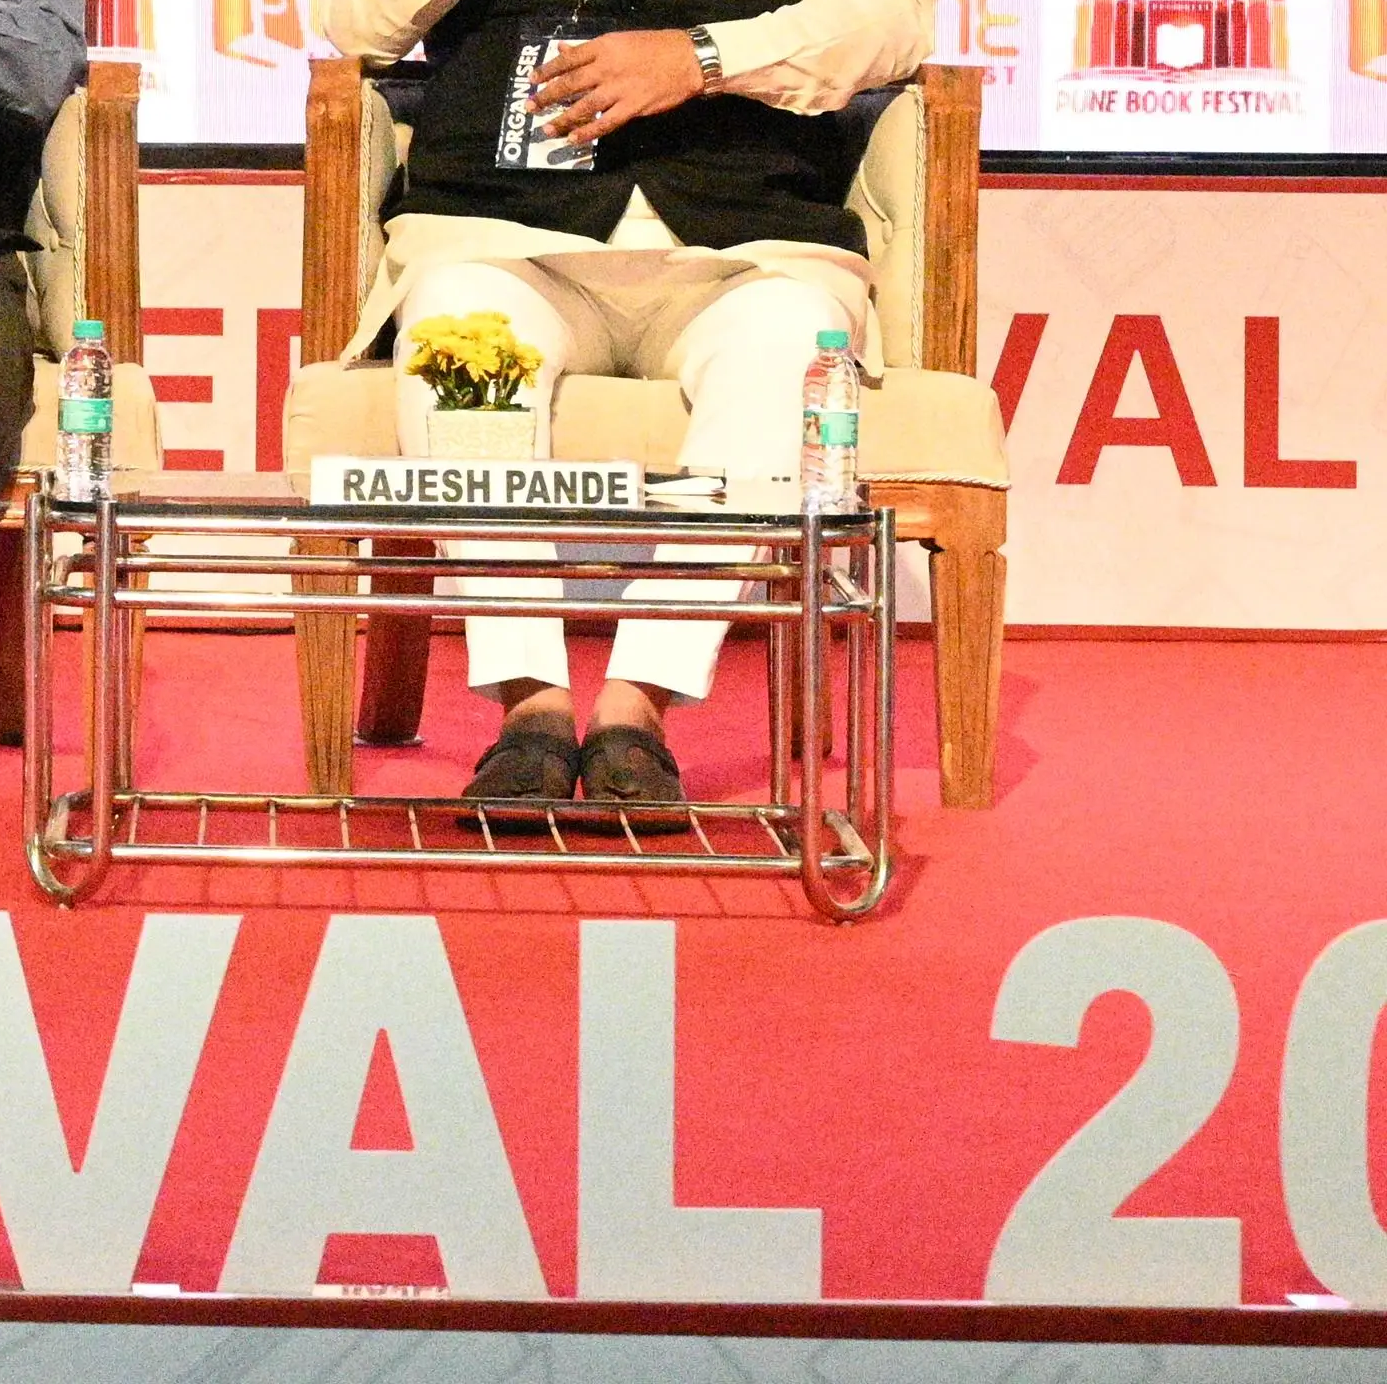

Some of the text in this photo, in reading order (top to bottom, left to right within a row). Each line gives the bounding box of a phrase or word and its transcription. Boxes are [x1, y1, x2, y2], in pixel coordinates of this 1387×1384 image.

[503, 44, 541, 162] ORGANISER
[1126, 90, 1194, 114] BOOK
[342, 468, 629, 506] RAJESH PANDE
